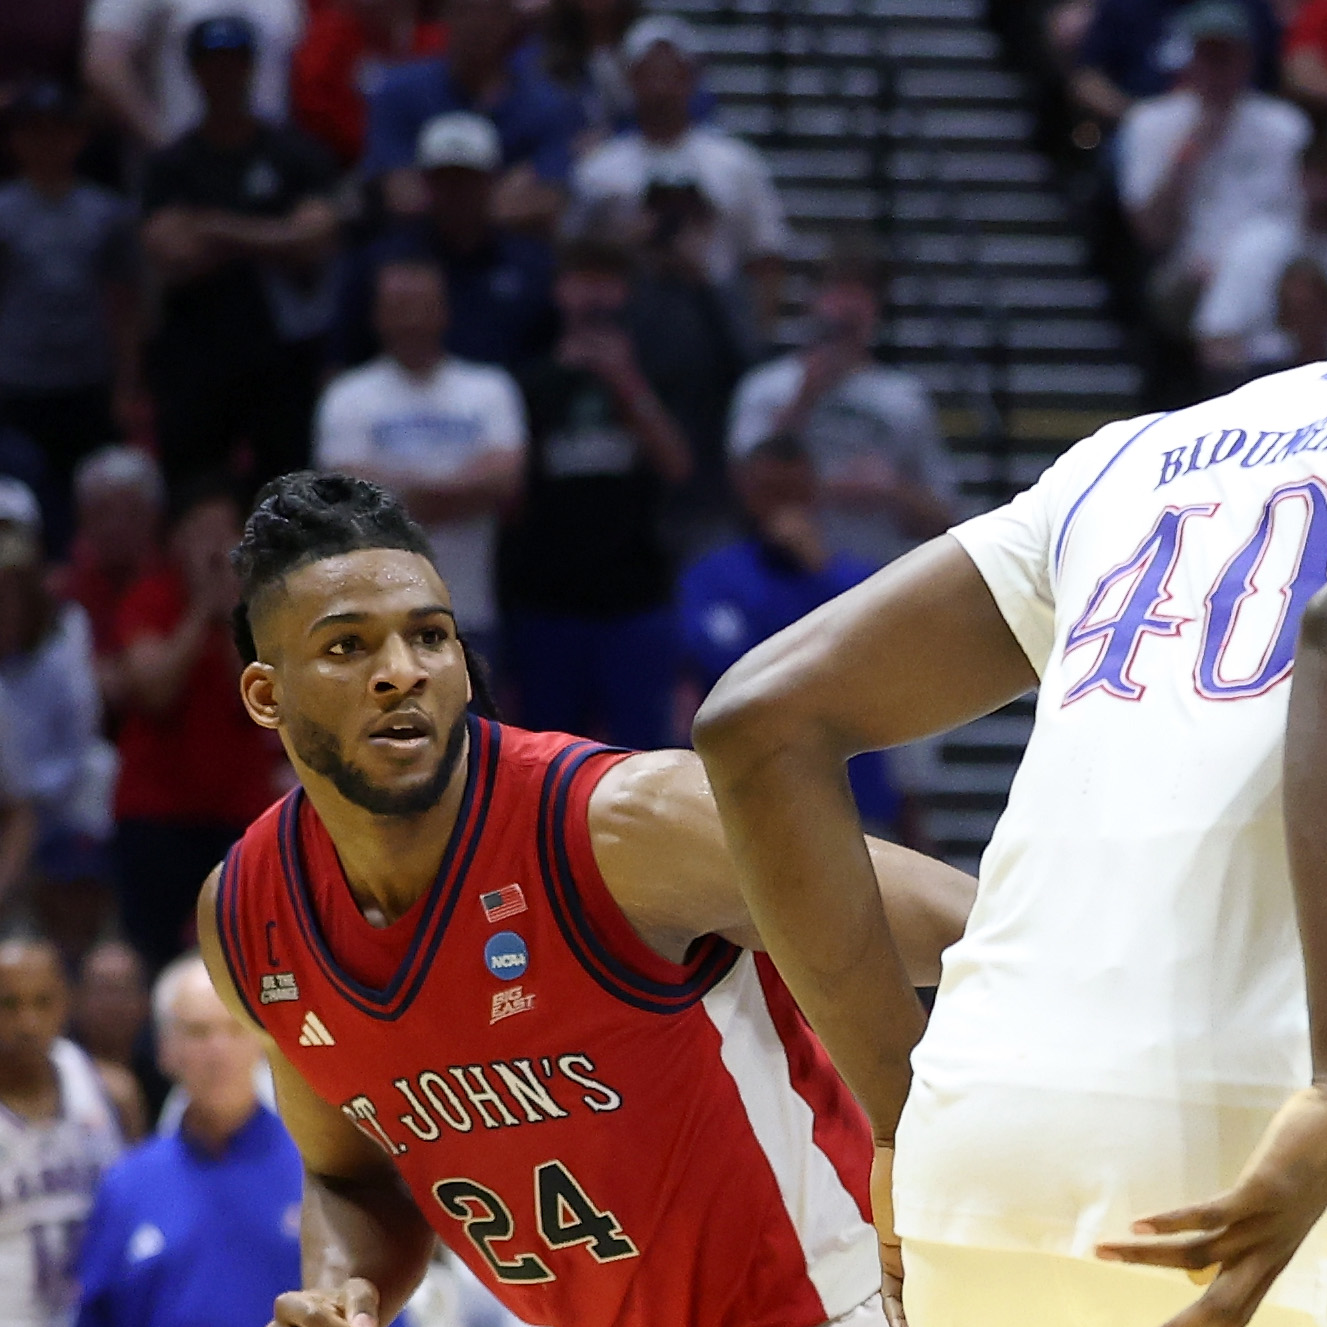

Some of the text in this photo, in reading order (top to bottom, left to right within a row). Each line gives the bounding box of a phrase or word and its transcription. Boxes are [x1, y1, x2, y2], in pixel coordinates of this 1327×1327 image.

[490, 953, 527, 969] NCAA
[393, 1053, 623, 1142] JOHN'S
[431, 1158, 640, 1285] 24
